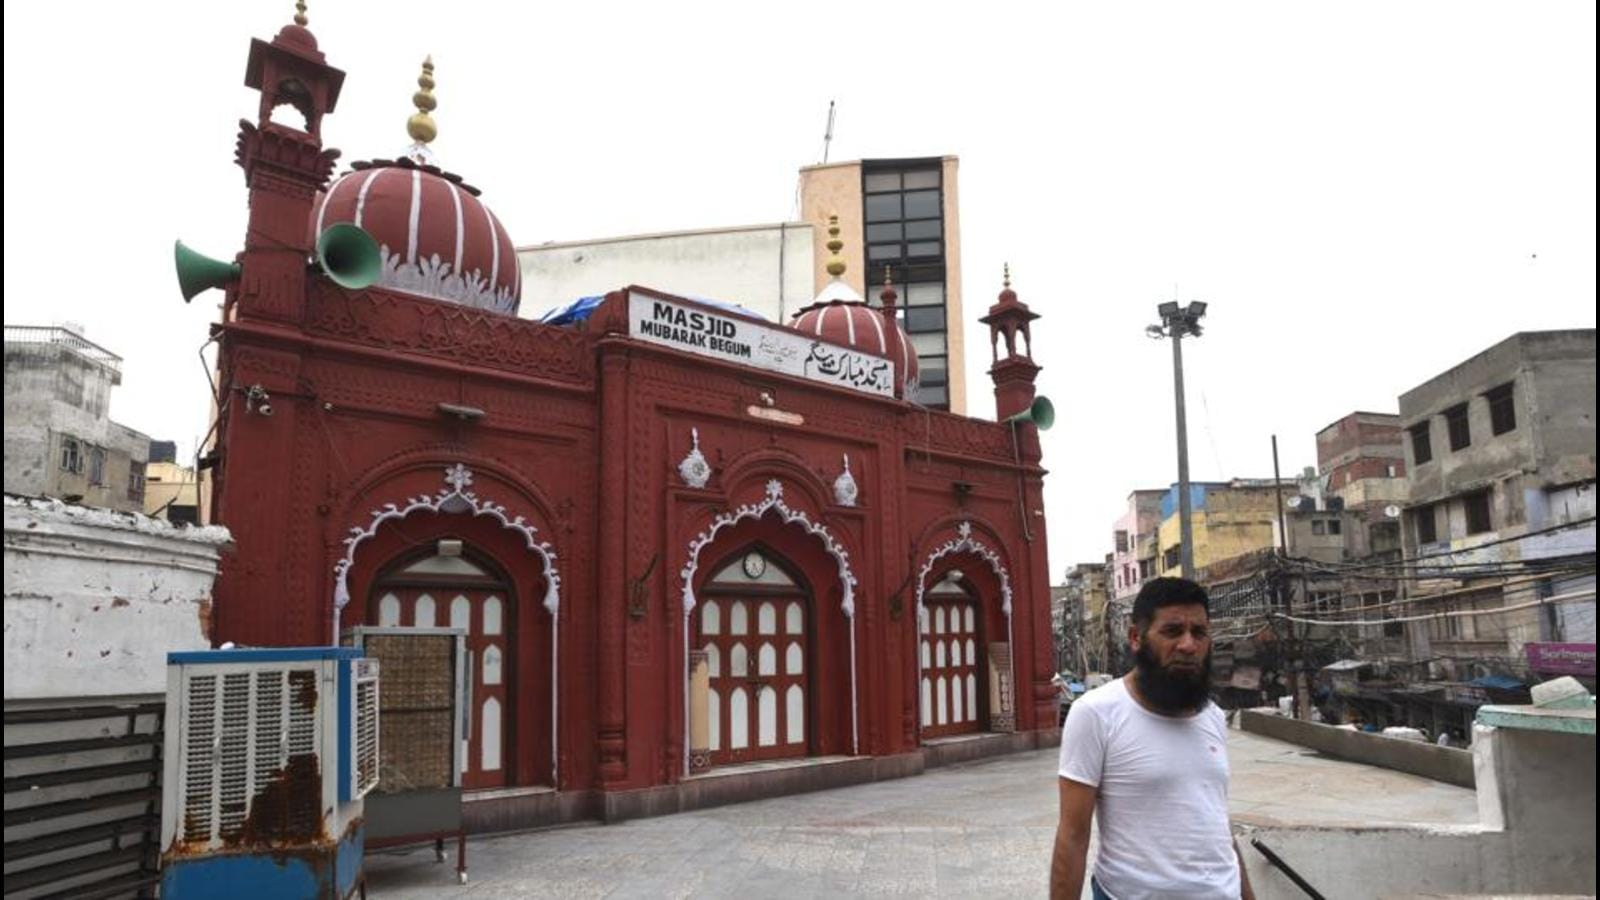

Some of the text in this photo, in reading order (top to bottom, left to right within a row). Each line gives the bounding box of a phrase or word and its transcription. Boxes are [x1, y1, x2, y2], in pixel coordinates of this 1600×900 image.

[640, 320, 706, 348] MUBARAK
[709, 337, 751, 358] BEGUM
[654, 302, 736, 339] MASJID
